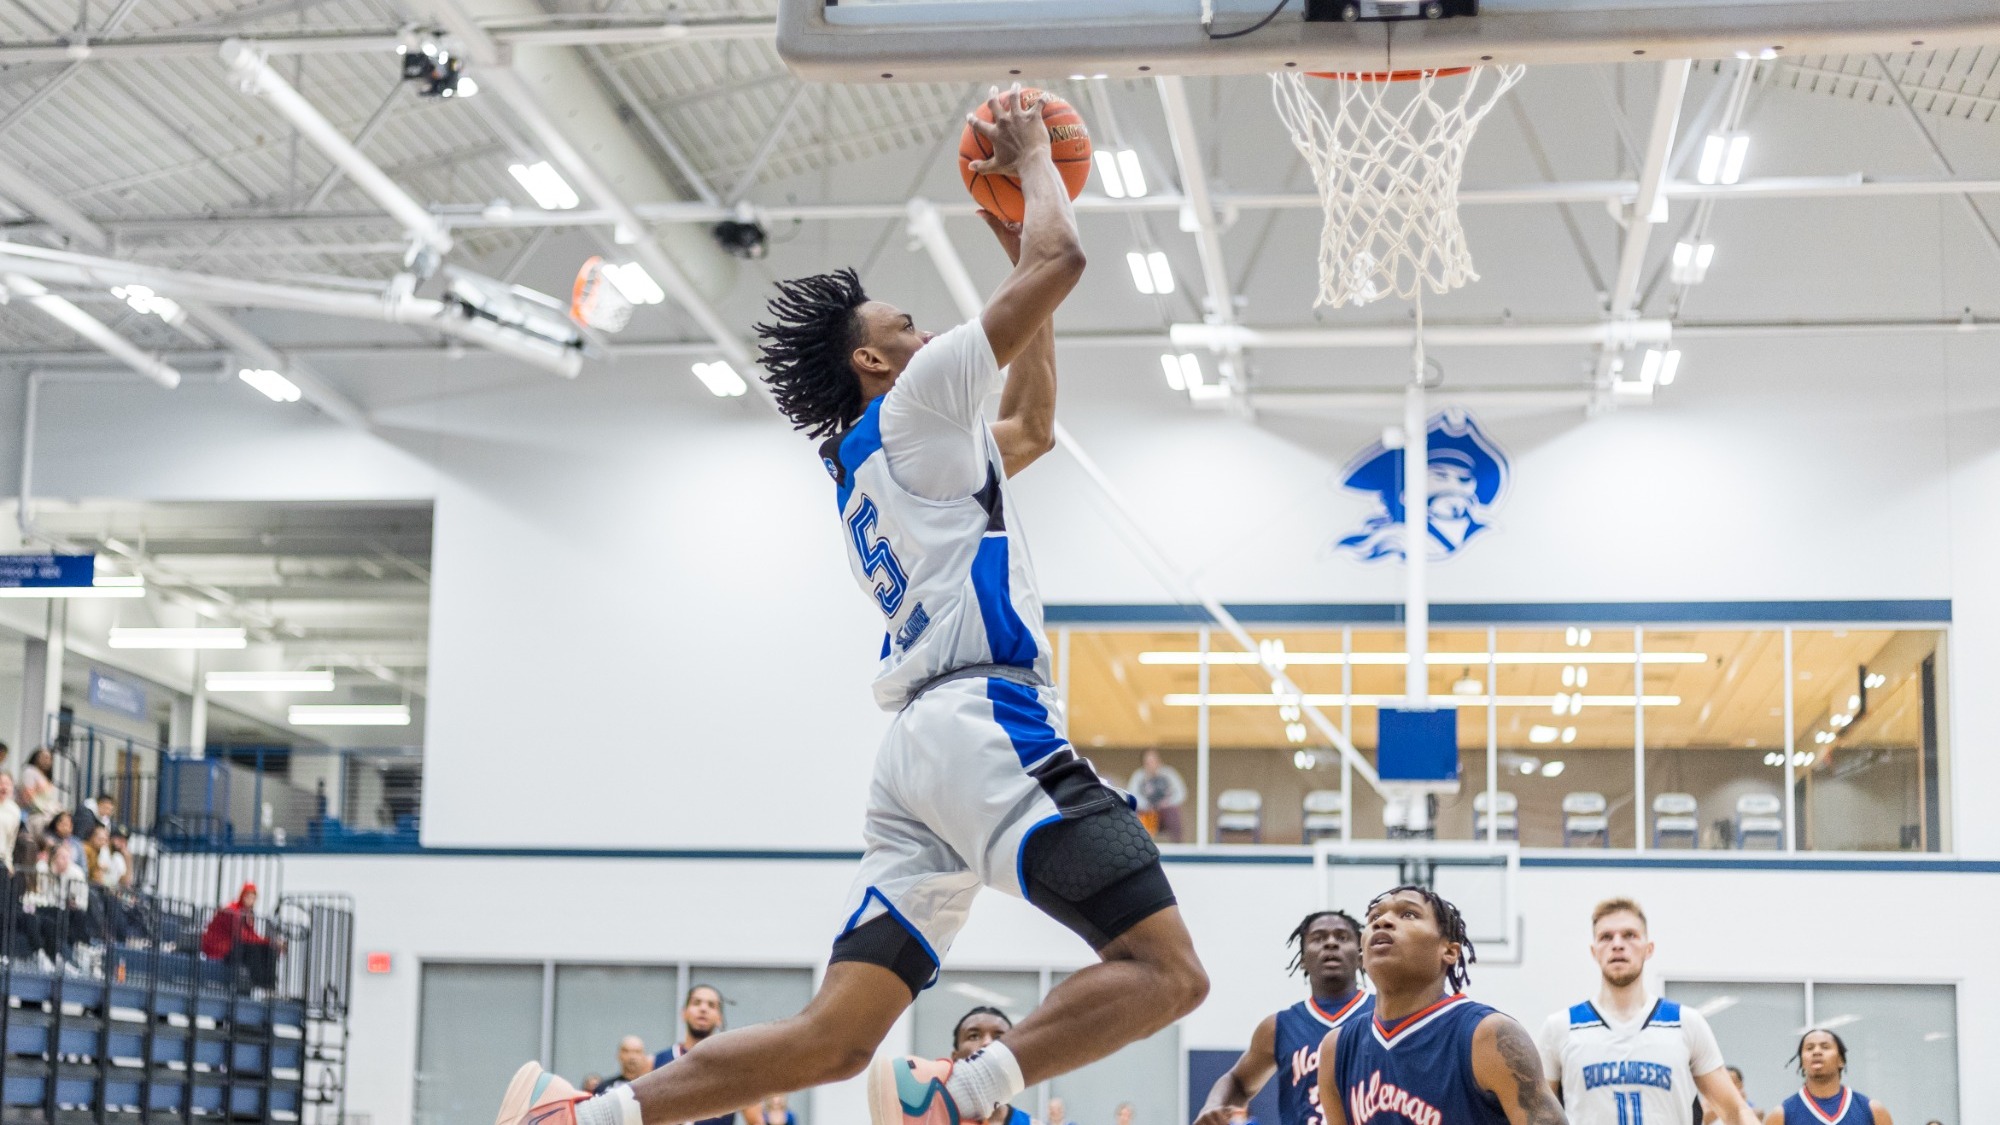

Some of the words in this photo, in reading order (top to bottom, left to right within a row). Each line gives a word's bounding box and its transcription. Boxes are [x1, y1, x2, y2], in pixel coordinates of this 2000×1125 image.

[848, 493, 909, 619] 5
[1583, 1060, 1672, 1091] BUCCANEERS
[1614, 1091, 1643, 1125] 11
